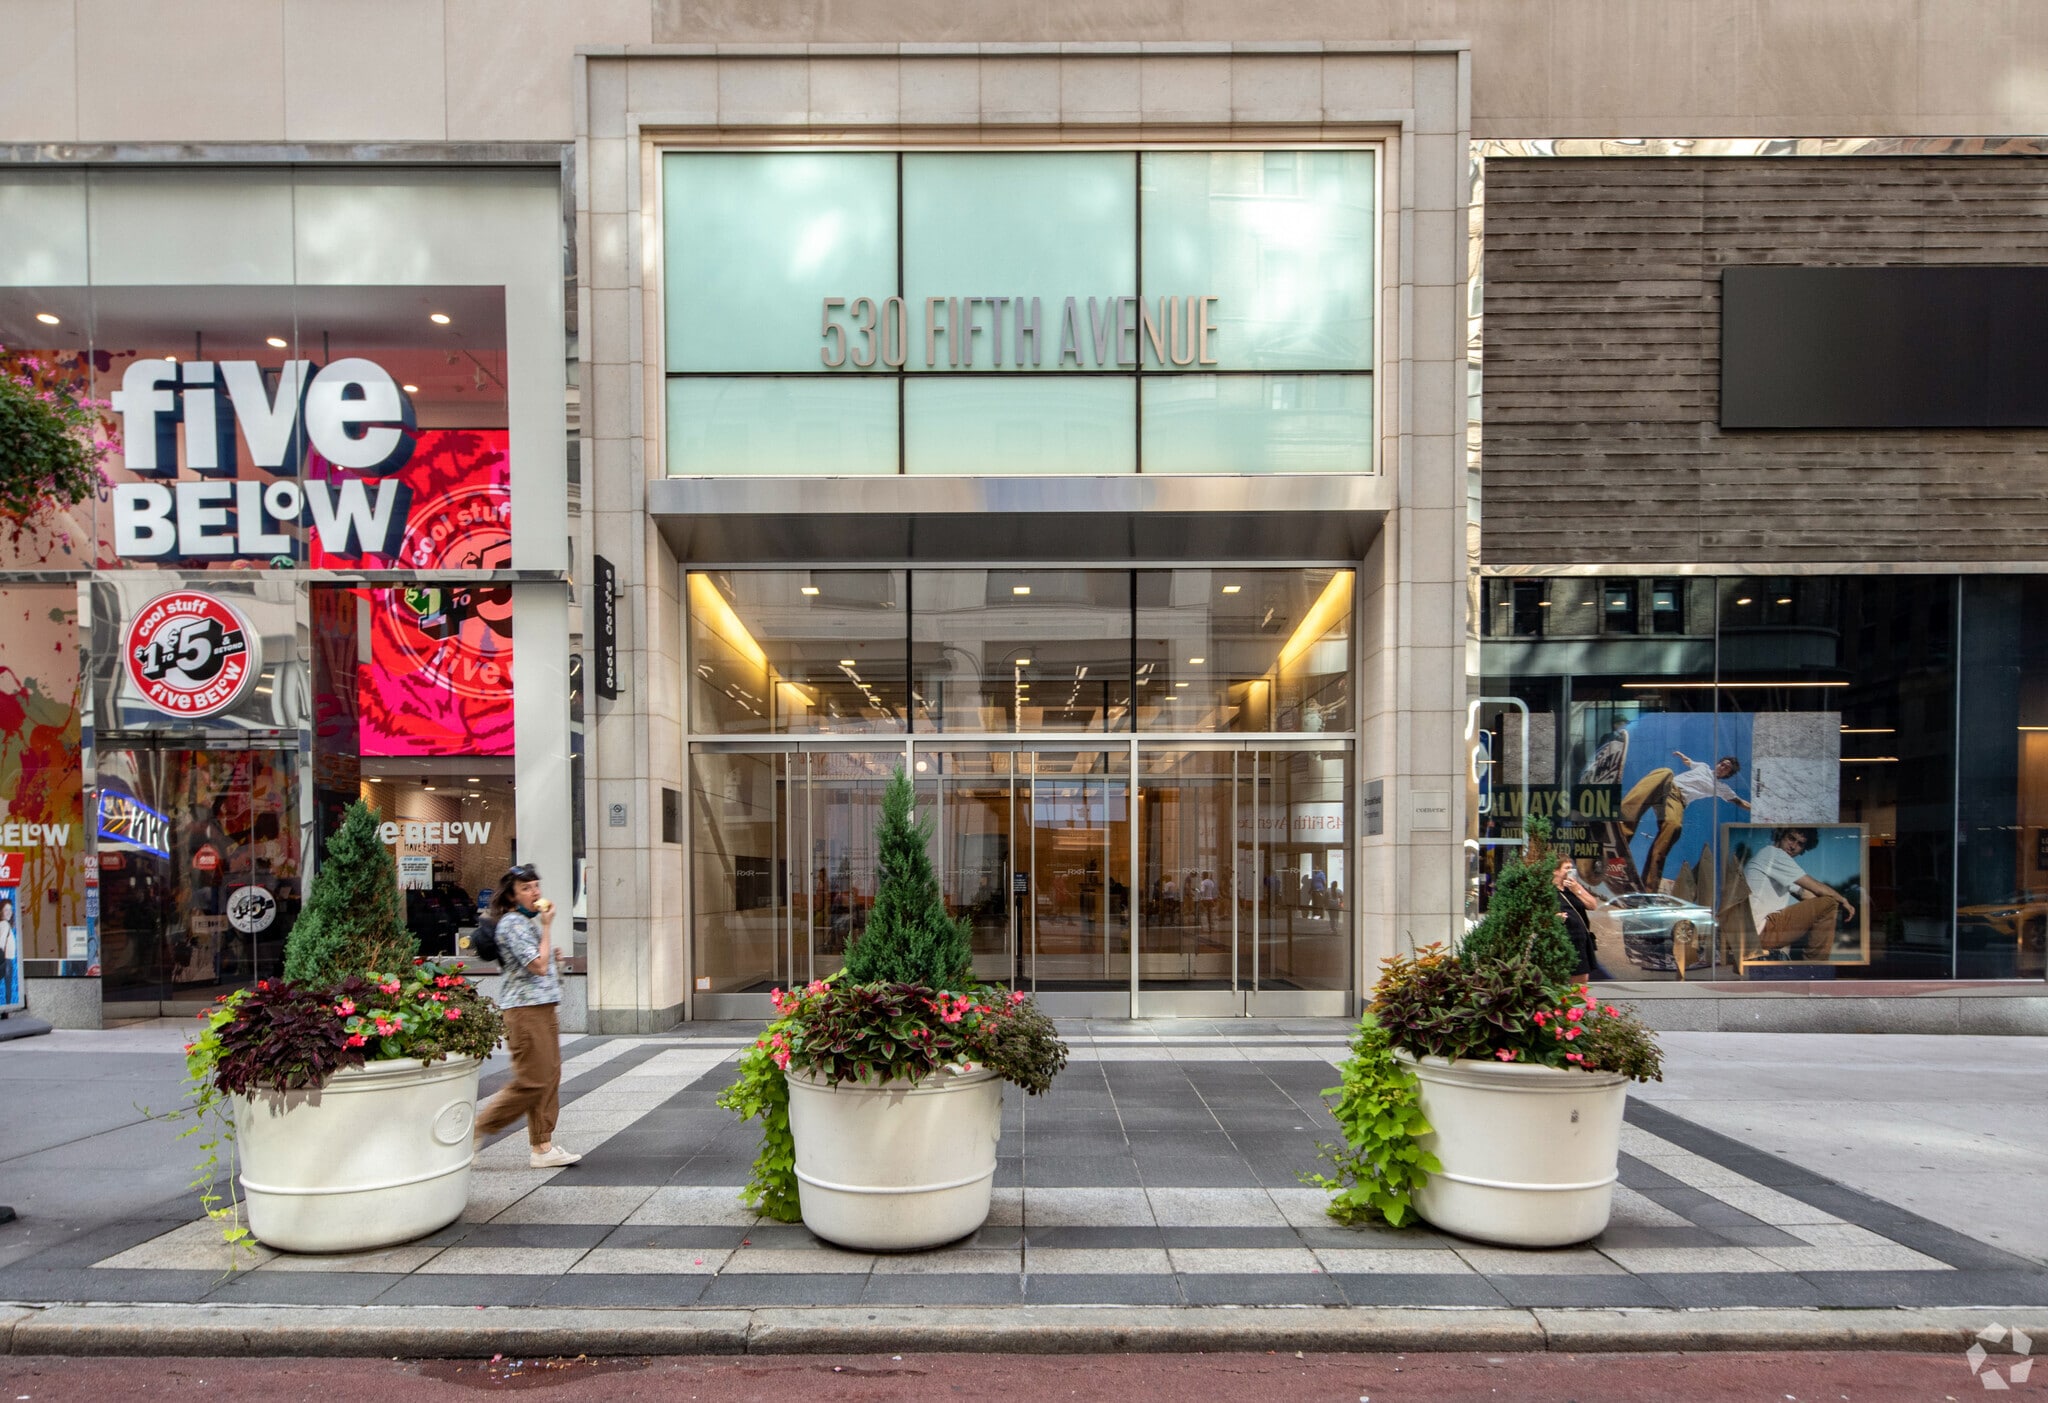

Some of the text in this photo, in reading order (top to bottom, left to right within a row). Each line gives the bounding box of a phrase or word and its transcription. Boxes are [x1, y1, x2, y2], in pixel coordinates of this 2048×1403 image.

[820, 295, 1219, 367] 530 FIFTH AVENUE
[111, 357, 404, 470] five
[112, 478, 402, 558] BELOW
[412, 501, 511, 567] cool stuf
[138, 599, 208, 637] cool stuff
[161, 652, 175, 663] TO
[167, 618, 213, 671] $5
[213, 641, 244, 656] BEYOND
[149, 660, 243, 709] five BELOW
[1579, 789, 1618, 818] ON.
[0, 823, 71, 847] ELOW
[404, 821, 492, 845] BELOW
[1556, 827, 1586, 839] CHINO
[1574, 843, 1600, 856] PANT.
